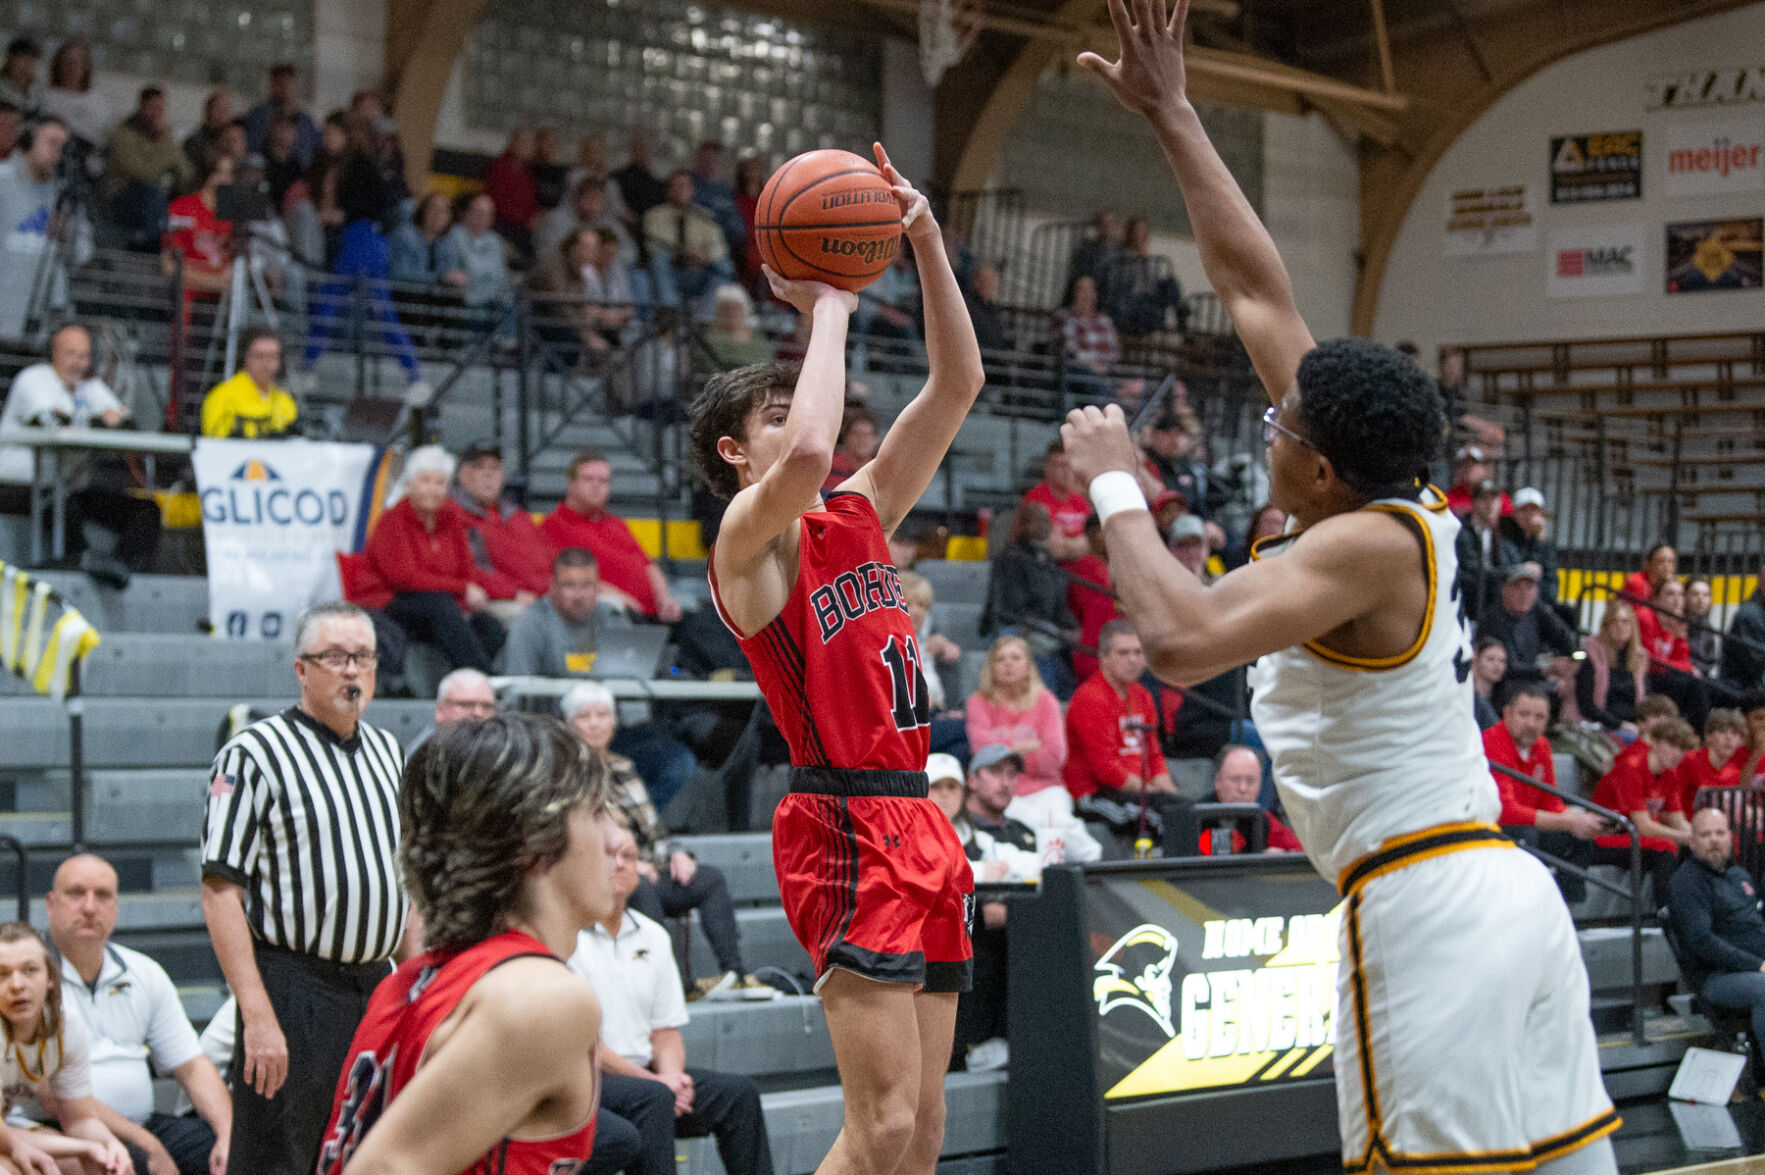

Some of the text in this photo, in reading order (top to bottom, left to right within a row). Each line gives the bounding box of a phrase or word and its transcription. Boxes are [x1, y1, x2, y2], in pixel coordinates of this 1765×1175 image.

[1668, 137, 1761, 178] meijer
[821, 234, 899, 263] Wilson
[202, 487, 347, 526] GLICOD
[880, 634, 931, 732] 11
[1202, 918, 1284, 959] HOME
